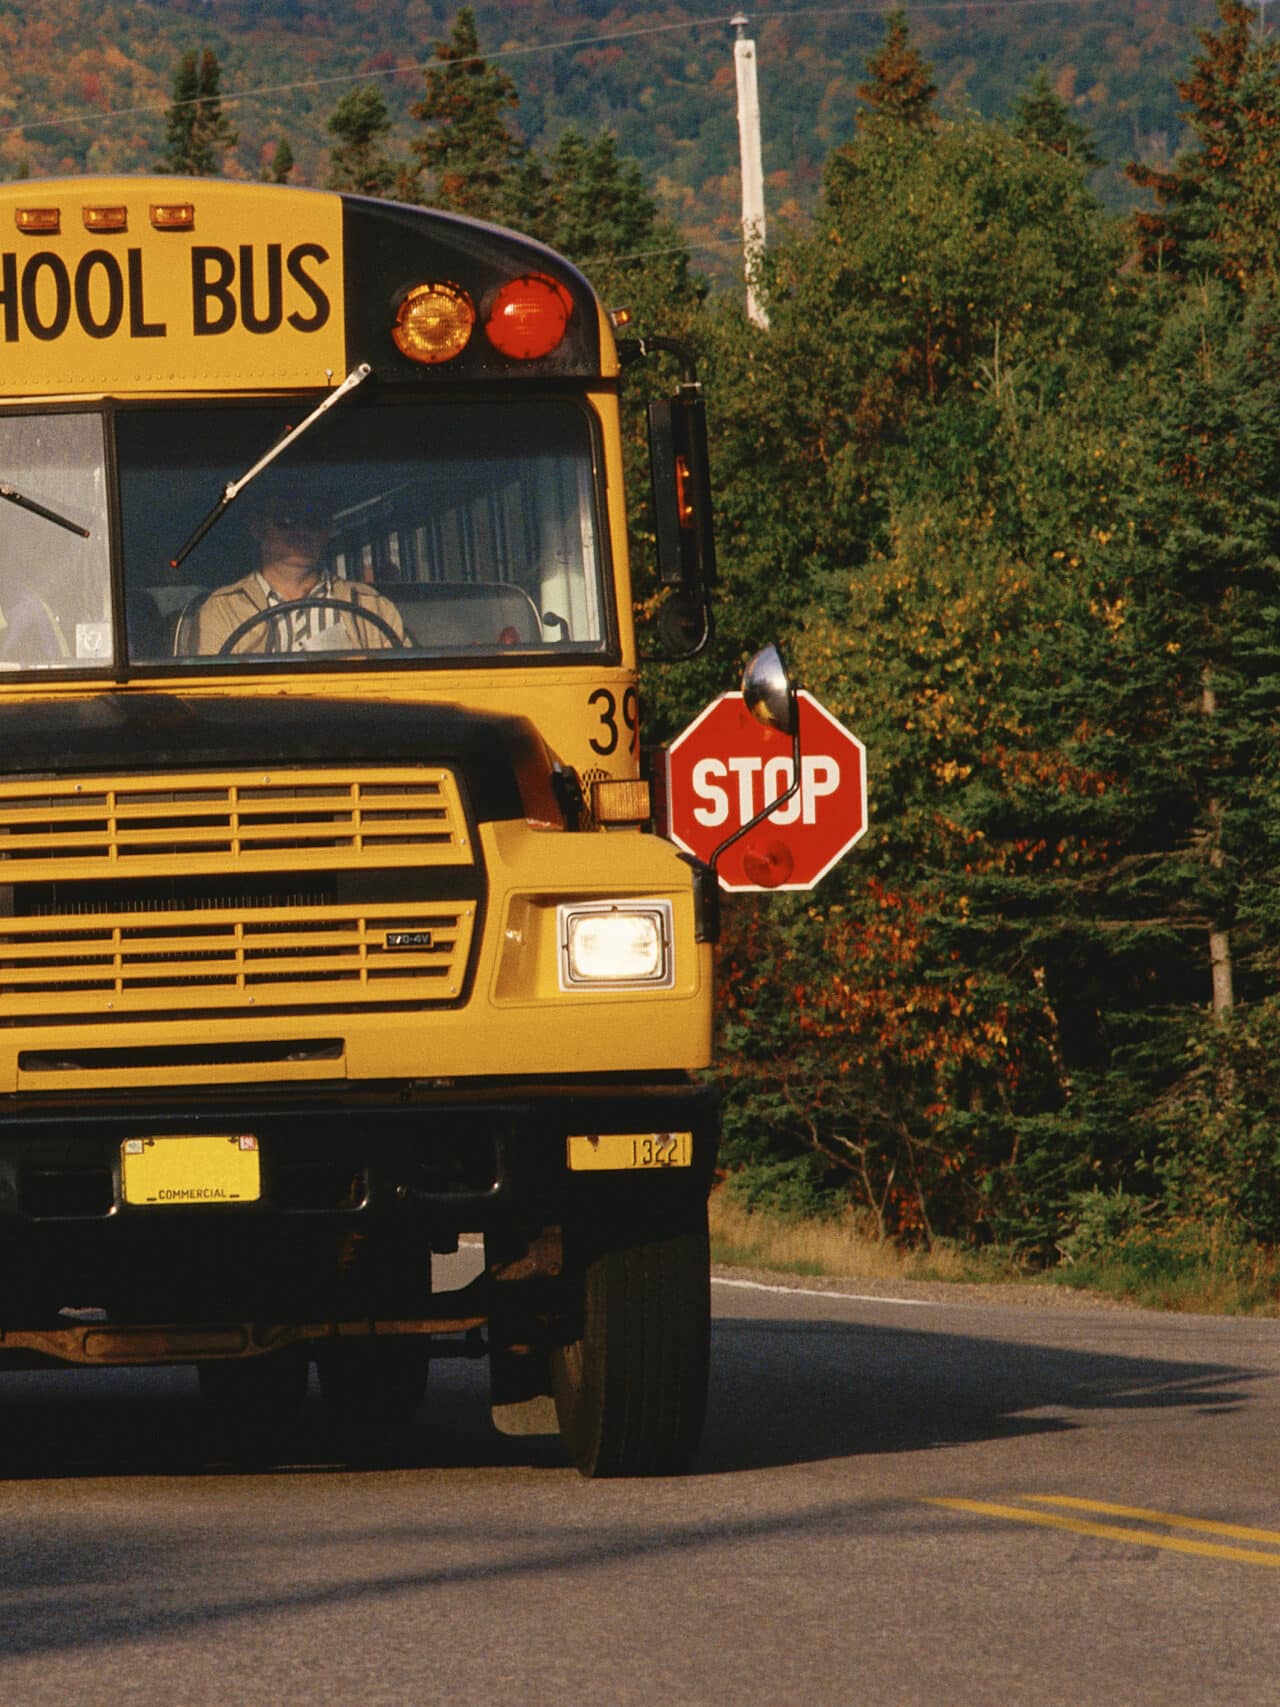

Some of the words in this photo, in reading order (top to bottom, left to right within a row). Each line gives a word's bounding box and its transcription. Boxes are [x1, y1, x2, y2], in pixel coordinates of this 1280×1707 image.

[191, 242, 331, 336] BUS
[692, 755, 840, 827] STOP
[158, 1188, 227, 1201] COMMERCIAL
